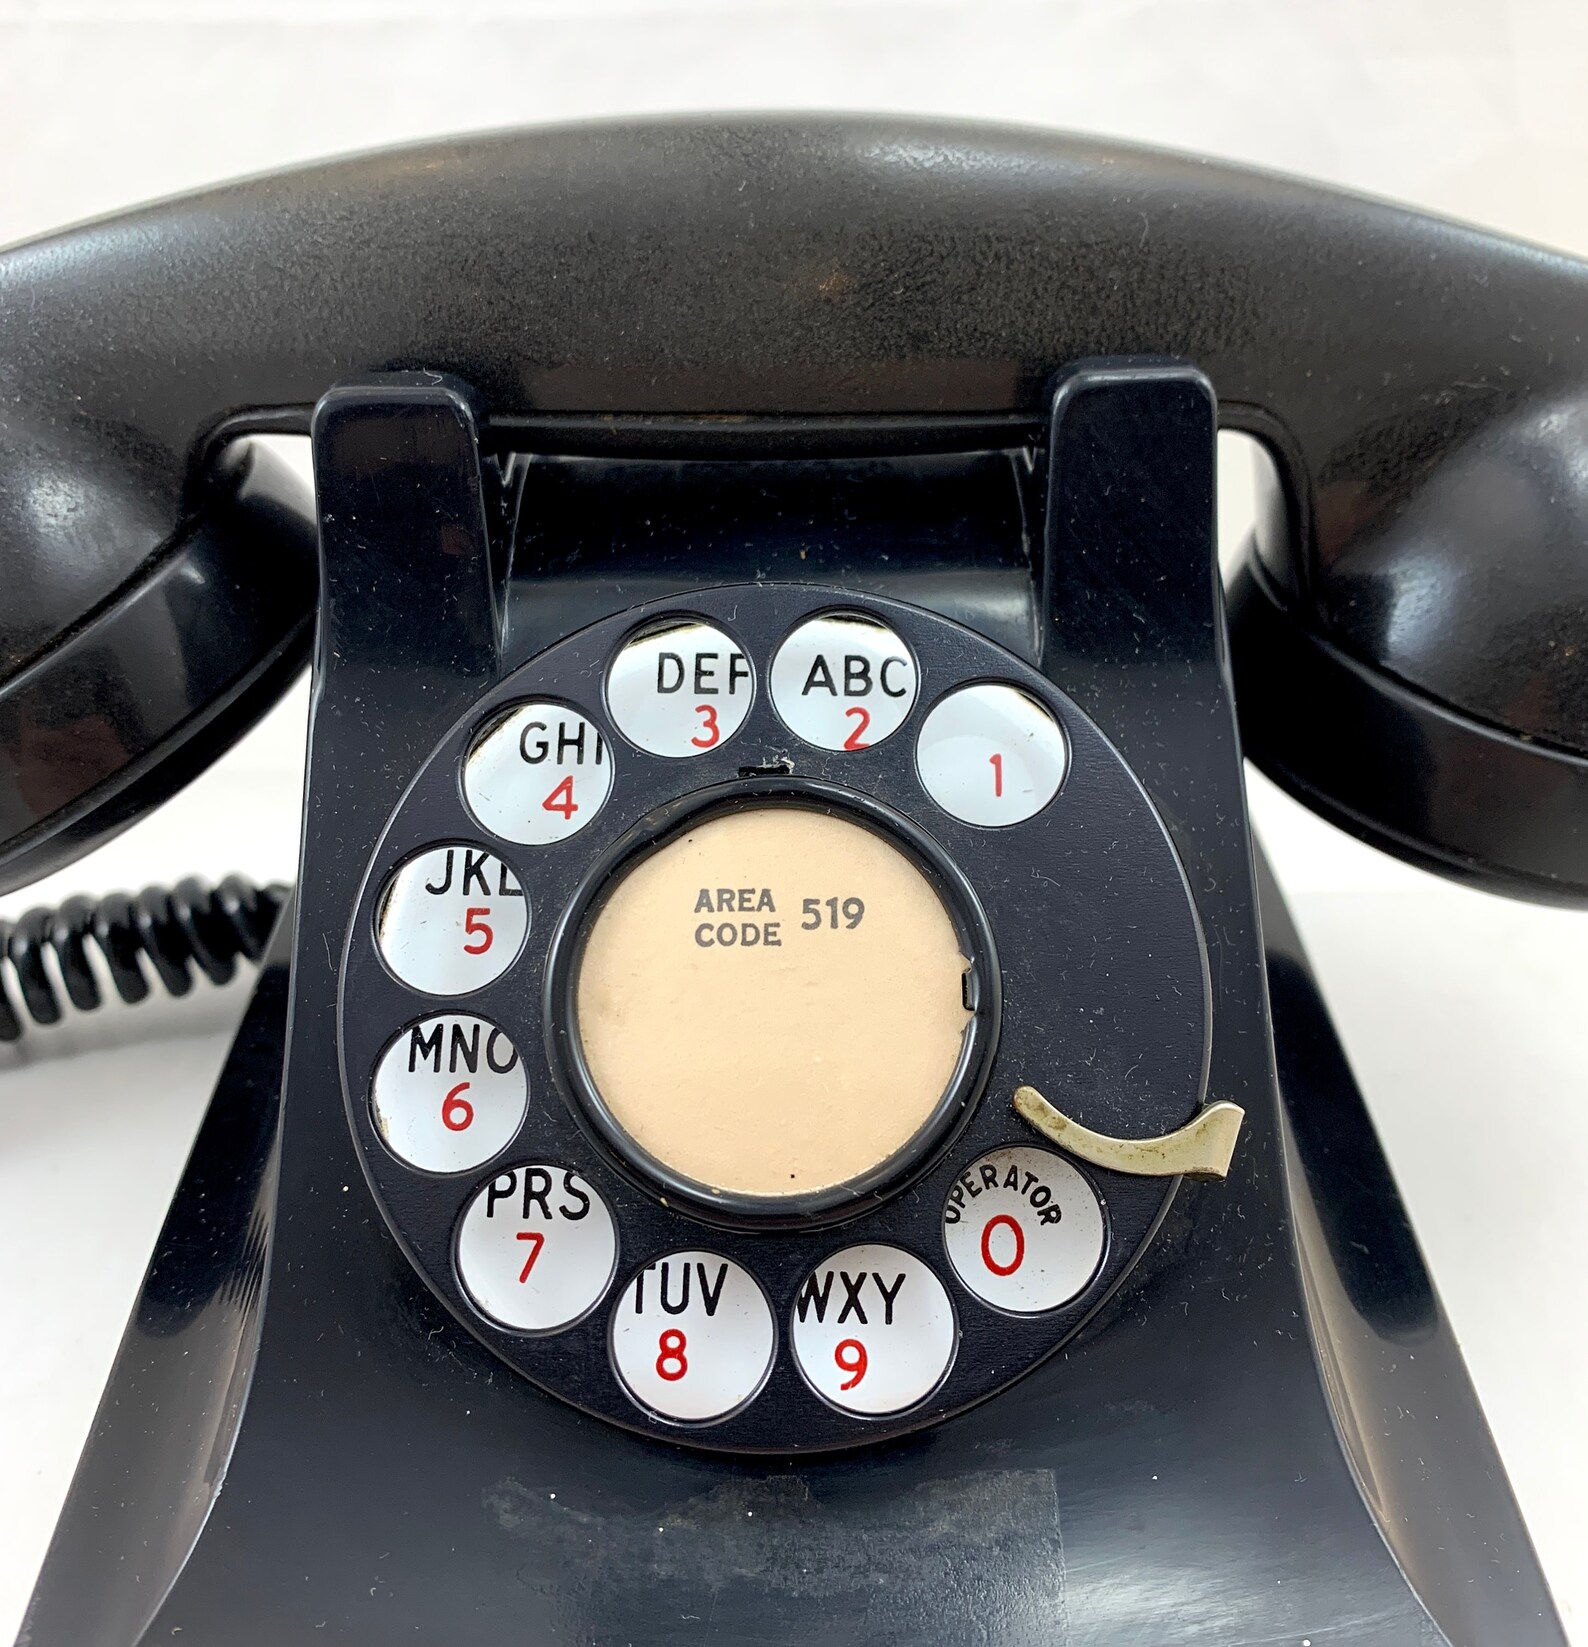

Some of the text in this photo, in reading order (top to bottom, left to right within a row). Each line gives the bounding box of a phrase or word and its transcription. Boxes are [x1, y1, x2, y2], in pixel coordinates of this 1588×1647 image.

[656, 652, 750, 695] DEF
[801, 654, 909, 697] ABC
[519, 722, 604, 765] GHI
[690, 704, 721, 748] 3
[843, 706, 871, 751] 2
[541, 775, 579, 820] 4
[989, 753, 1003, 797] 1
[424, 849, 524, 896] JKL
[463, 907, 494, 955] 5
[693, 887, 866, 931] AREA 519
[693, 922, 783, 948] CODE
[408, 1023, 518, 1074] MNO
[441, 1082, 475, 1132] 6
[485, 1167, 591, 1221] PRS
[944, 1164, 1063, 1226] OPERATOR
[515, 1231, 546, 1284] 7
[980, 1214, 1025, 1277] 0
[632, 1261, 729, 1317] TUV
[797, 1270, 907, 1325] WXY
[655, 1328, 688, 1382] 8
[834, 1338, 869, 1391] 9
